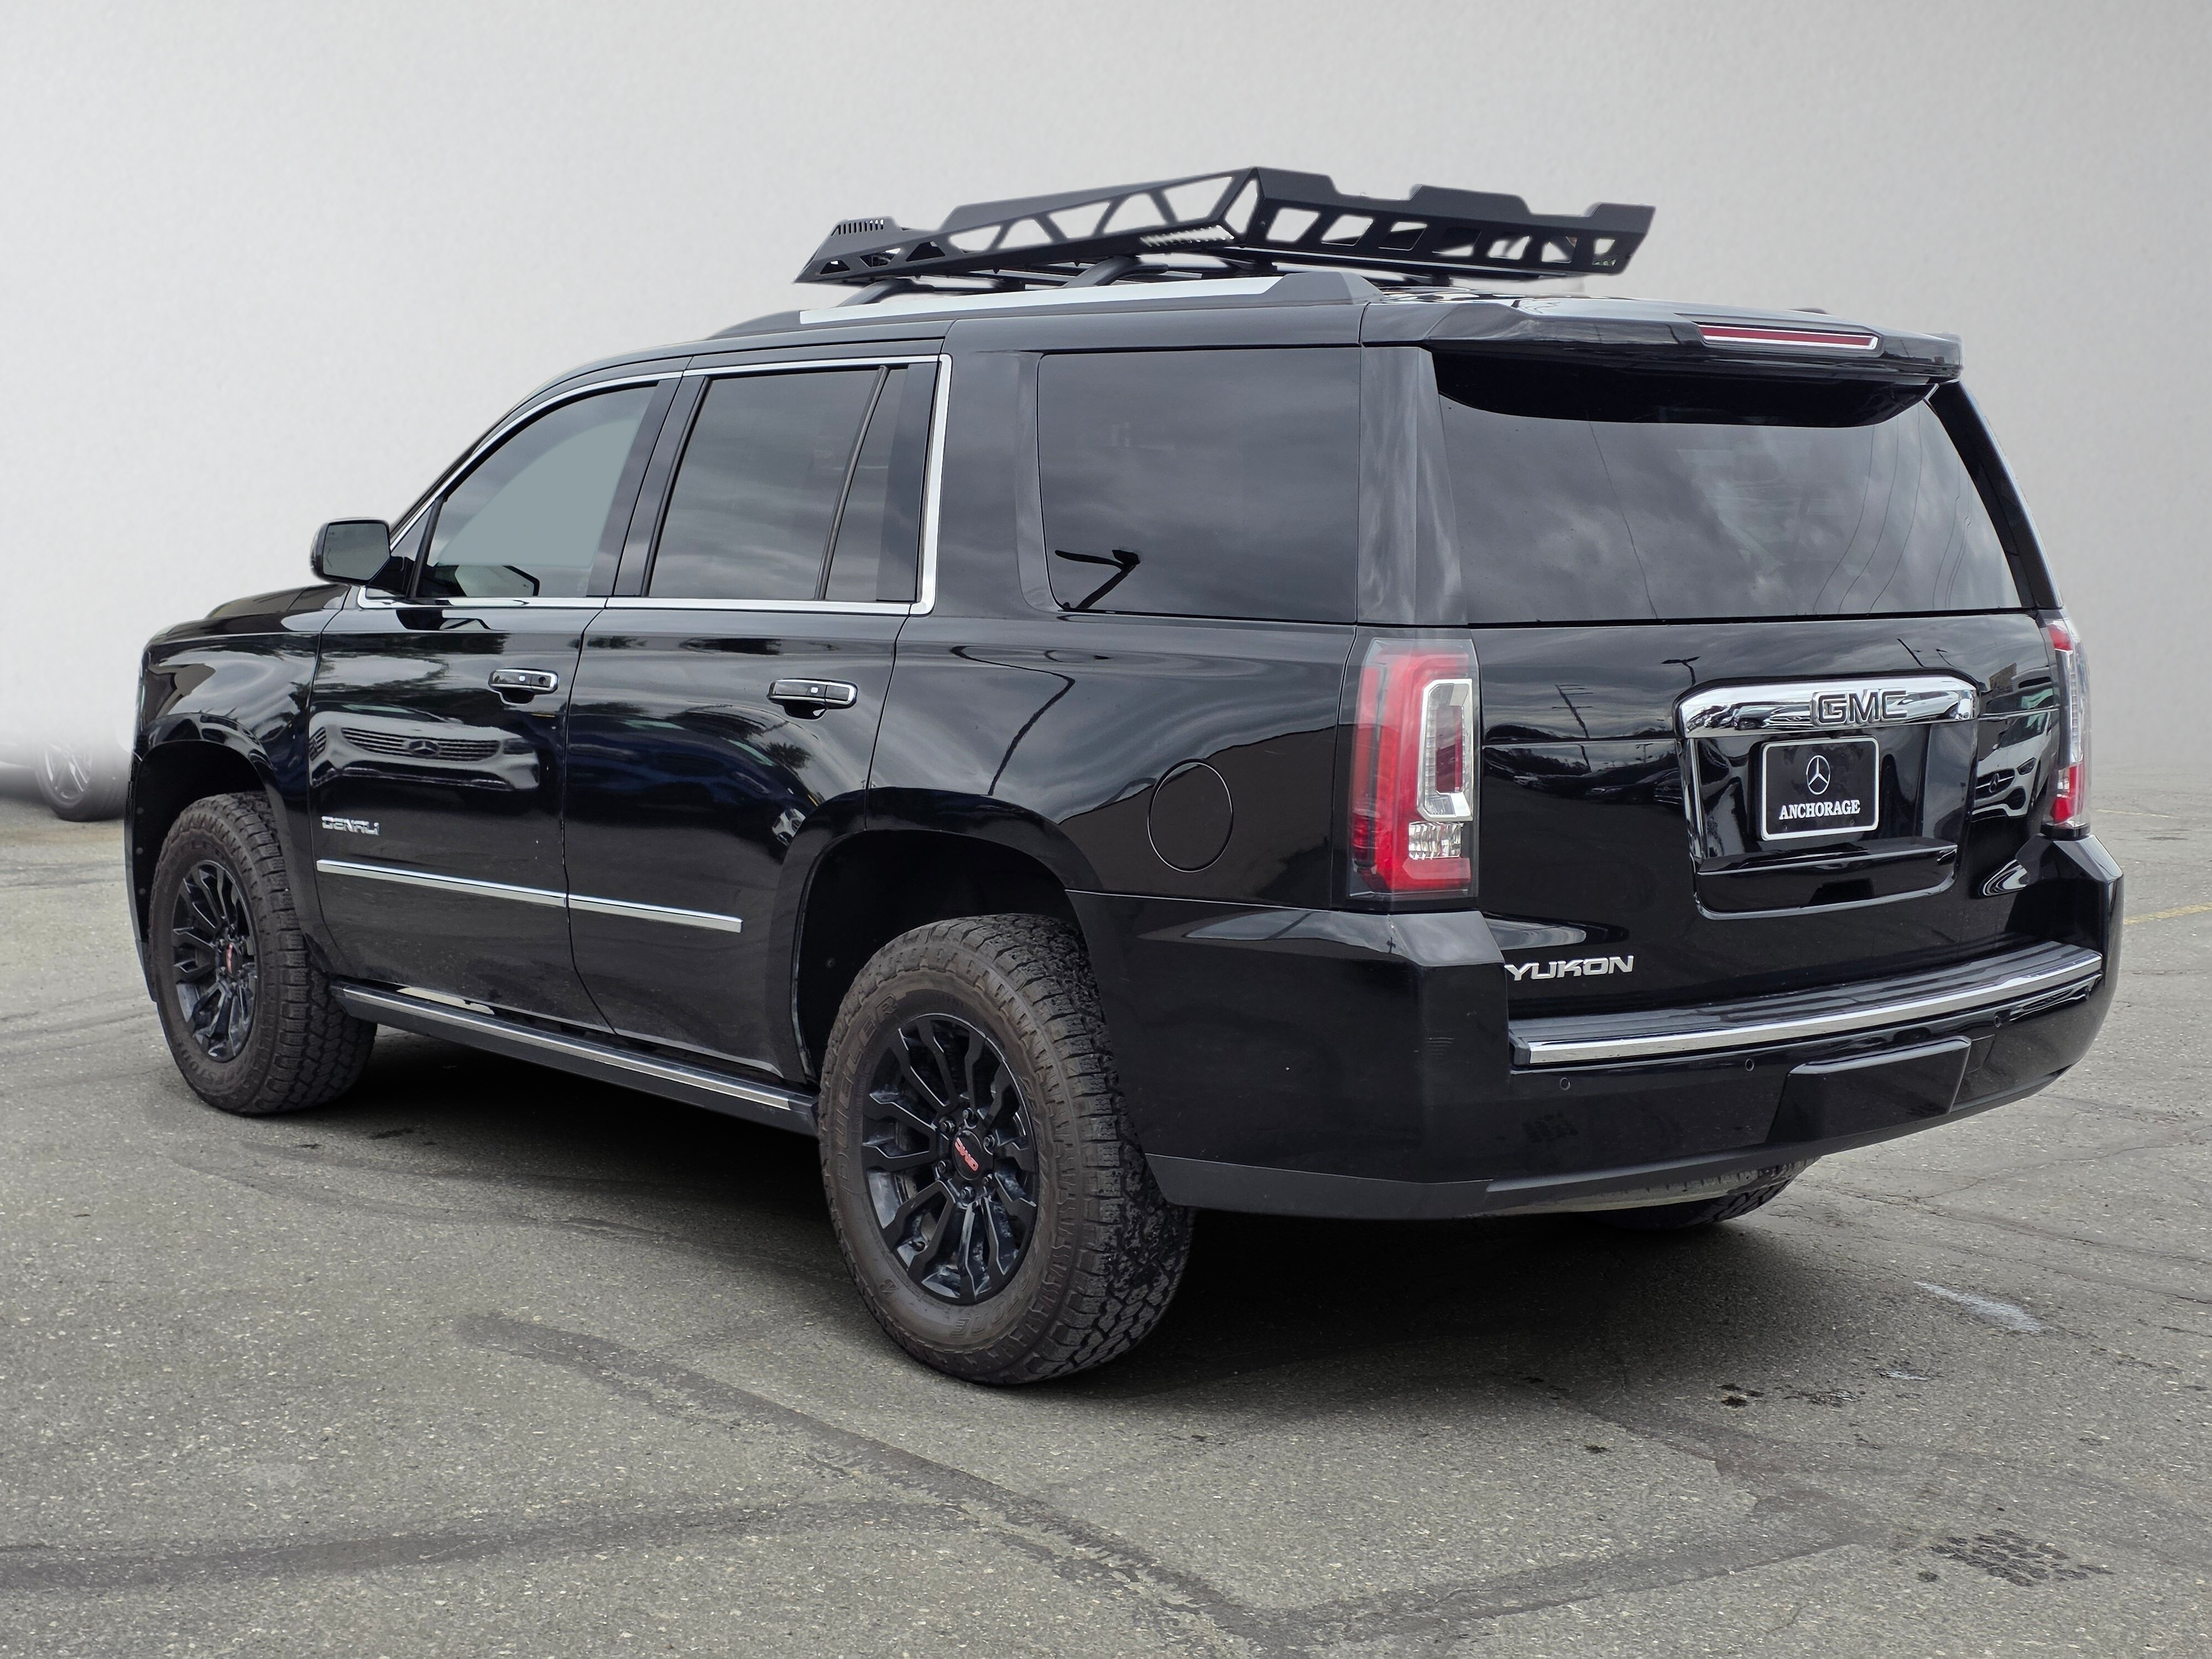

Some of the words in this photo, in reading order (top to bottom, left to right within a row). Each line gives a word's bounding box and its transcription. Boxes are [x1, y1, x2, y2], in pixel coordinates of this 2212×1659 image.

[1812, 688, 1908, 726] GMC
[1779, 800, 1860, 820] ANCHORAGE
[321, 816, 379, 836] DENALI
[1504, 955, 1634, 981] YUKON
[836, 994, 899, 1189] DUELER
